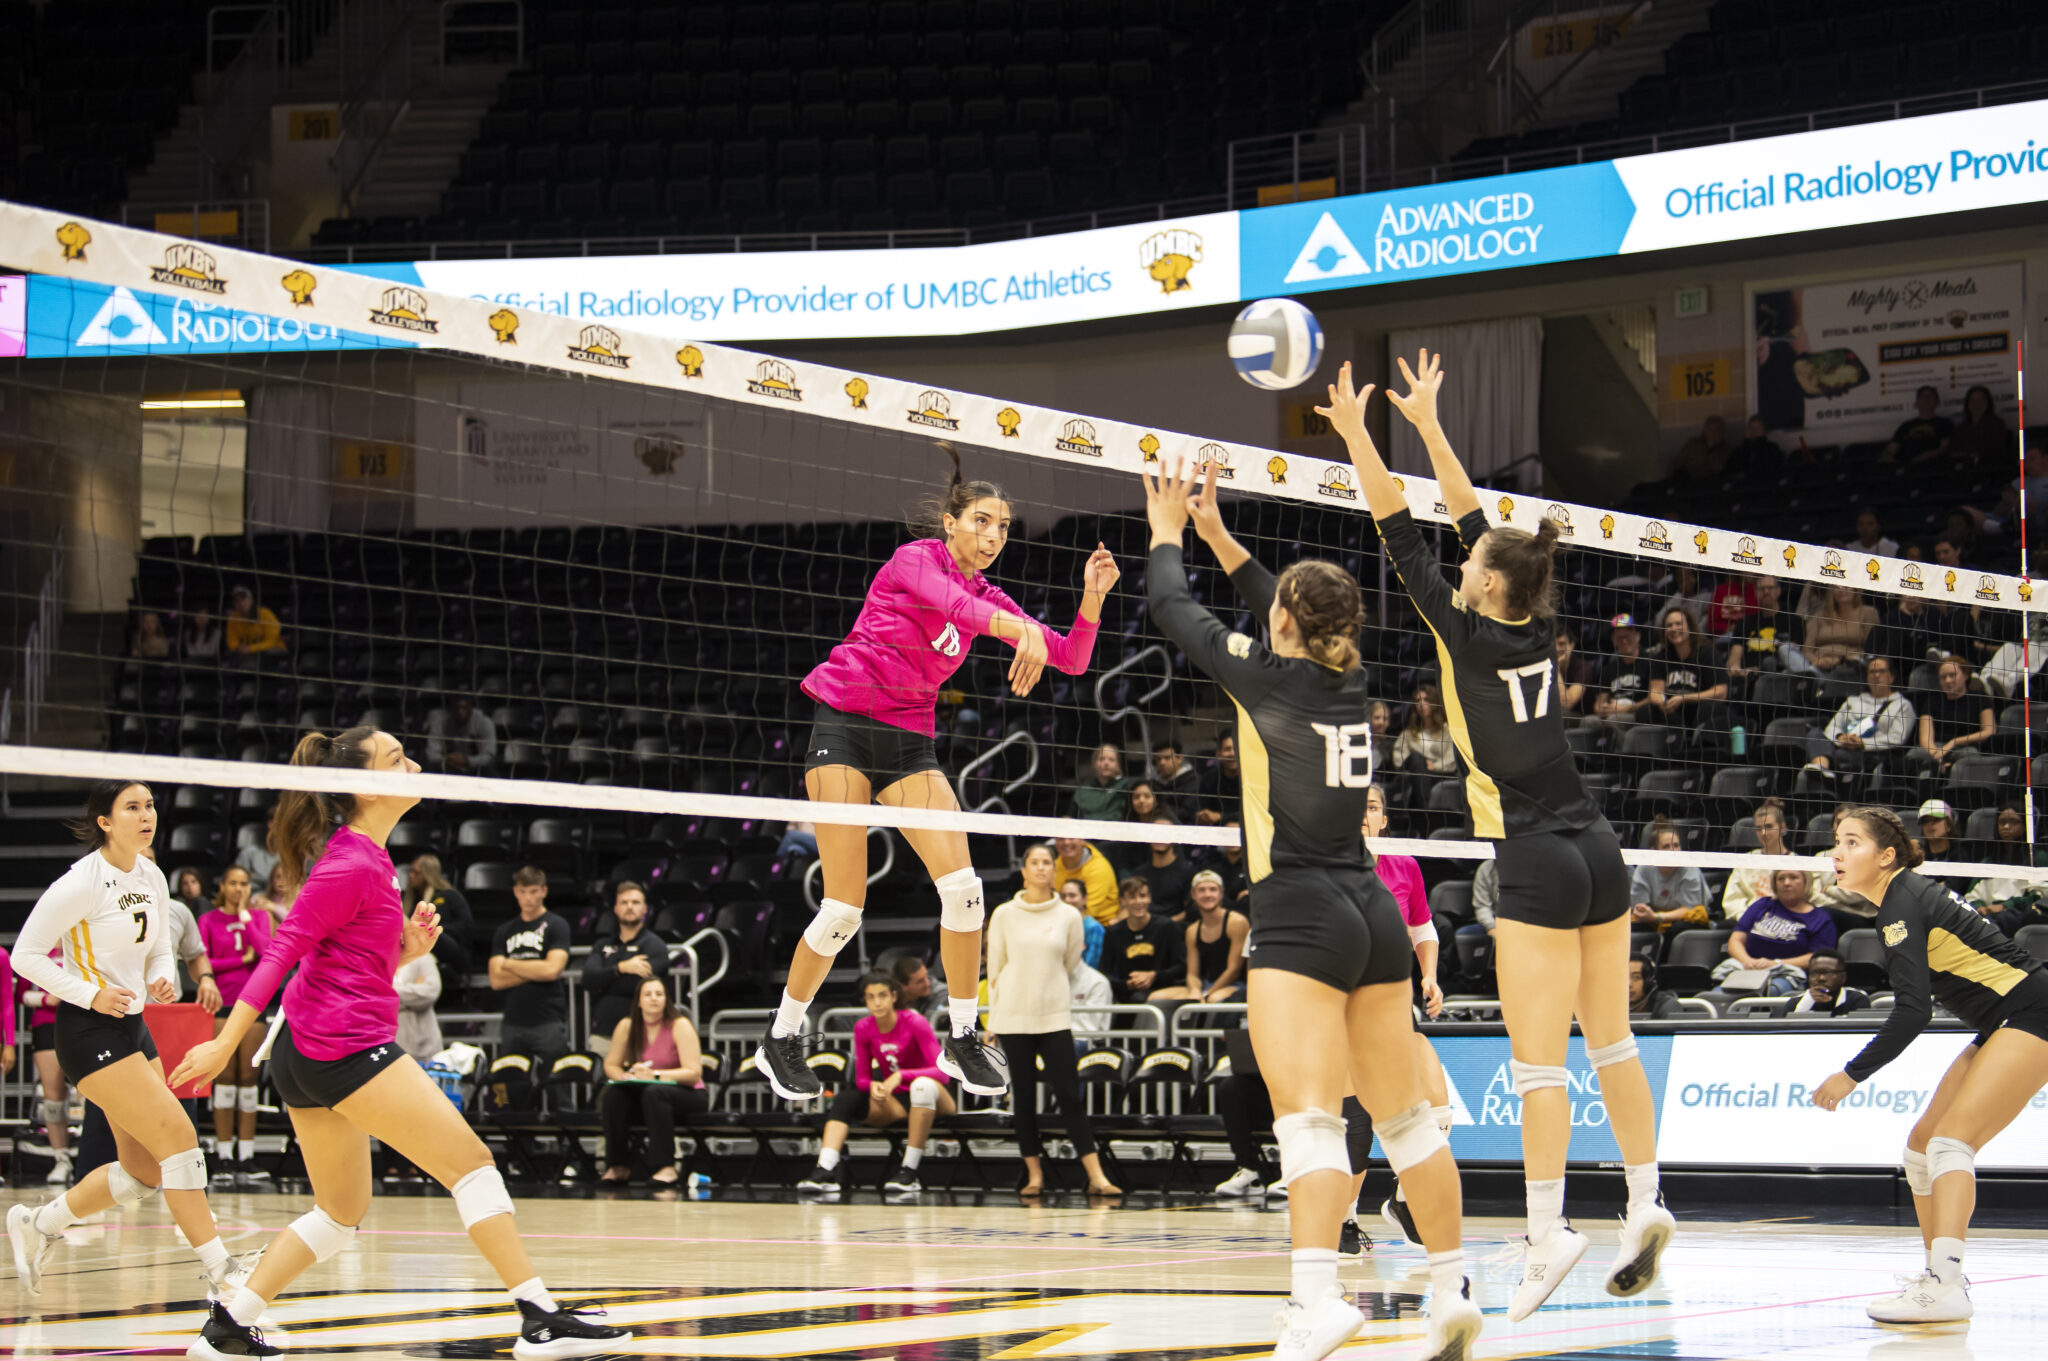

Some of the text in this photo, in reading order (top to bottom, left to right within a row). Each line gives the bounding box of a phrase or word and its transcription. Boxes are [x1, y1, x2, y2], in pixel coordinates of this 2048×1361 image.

[1665, 174, 1774, 219] Official
[1783, 160, 1942, 204] Radiology
[1375, 192, 1535, 238] ADVANCED
[165, 243, 217, 280] UMBC
[1140, 229, 1204, 269] UMBC
[1374, 224, 1544, 273] RADIOLOGY
[156, 270, 224, 294] VOLLEYBALL
[579, 289, 725, 322] Radiology
[733, 285, 858, 313] Provider
[865, 283, 896, 312] of
[902, 278, 998, 310] UMBC
[1004, 266, 1112, 304] Athletics
[1847, 276, 1978, 315] Mighty Meals
[382, 287, 428, 321] UMBC
[374, 313, 436, 333] VOLLEYBALL
[579, 325, 621, 356] UMBC
[571, 349, 627, 368] VOLLEYBALL
[757, 359, 796, 391] UMBC
[1685, 371, 1714, 397] 105
[750, 384, 801, 402] VOLLEYBALL
[918, 390, 951, 420] UMBC
[910, 413, 957, 431] VOLLEYBALL
[1324, 465, 1351, 491] UMBC
[1497, 658, 1553, 723] 17
[1310, 722, 1373, 788] 18
[118, 893, 152, 911] UMBC
[133, 911, 148, 944] 7
[1681, 1083, 1779, 1109] Official
